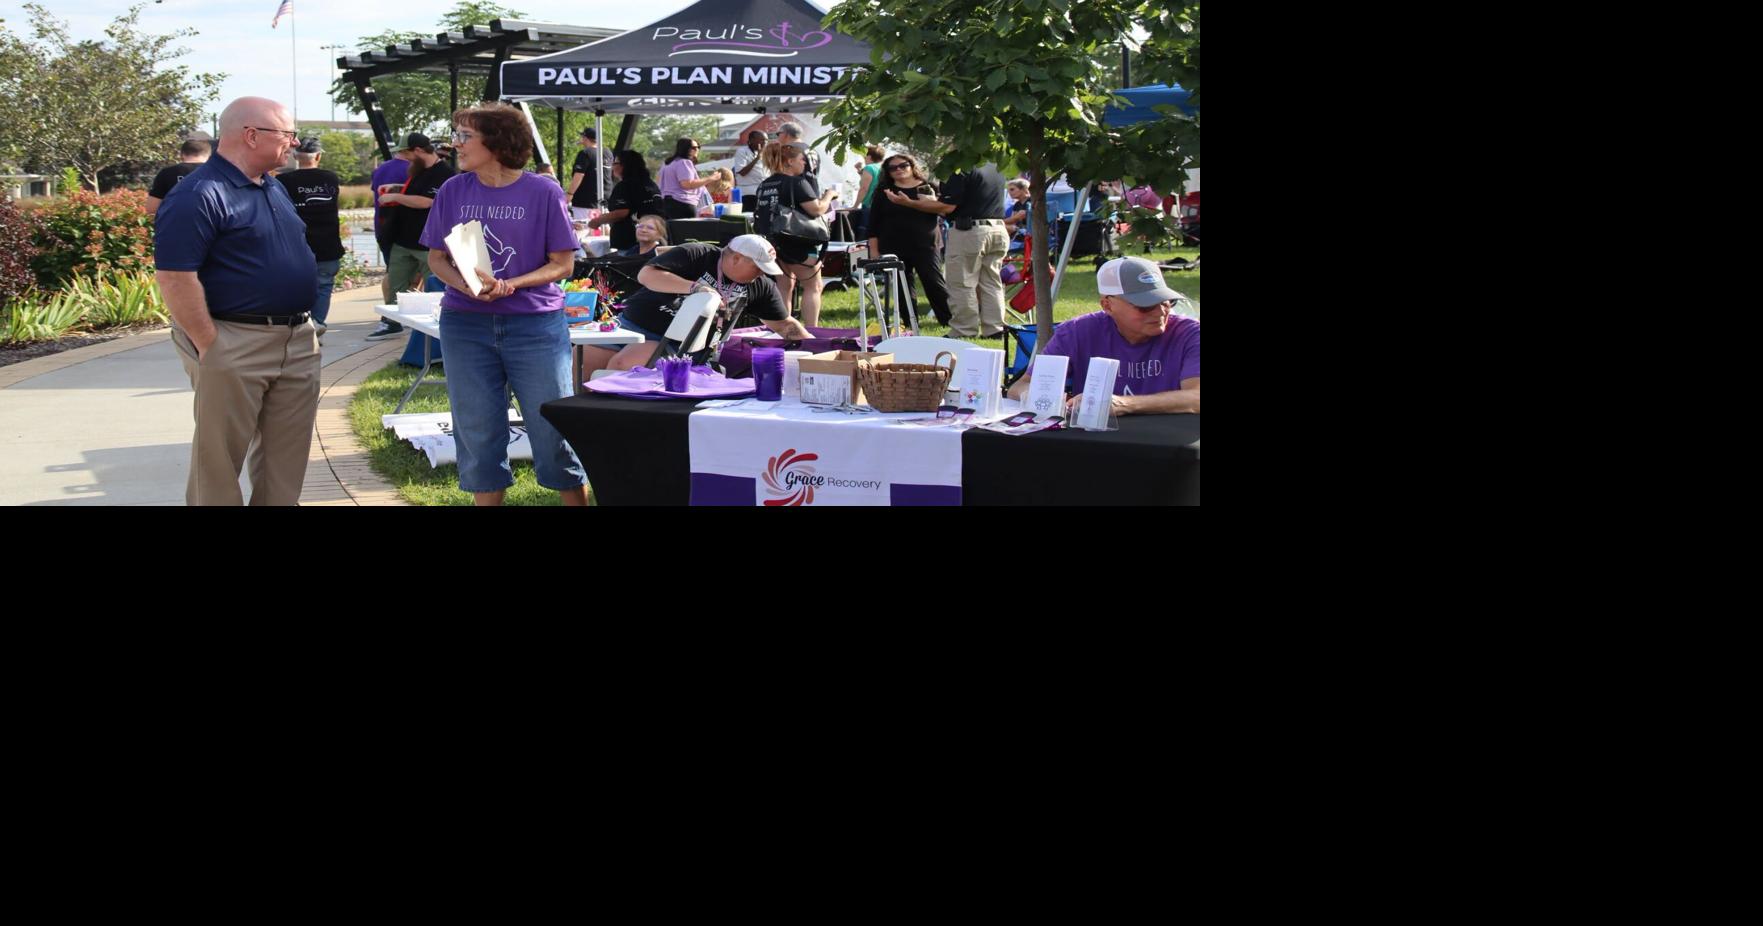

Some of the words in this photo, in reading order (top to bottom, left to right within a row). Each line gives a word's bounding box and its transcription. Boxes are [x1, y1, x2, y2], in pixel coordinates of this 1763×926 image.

[652, 23, 763, 41] Paul's
[538, 66, 642, 86] PAUL'S
[651, 66, 733, 85] PLAN
[459, 204, 484, 219] STILL
[785, 471, 825, 490] Grace
[827, 477, 881, 491] Recovery
